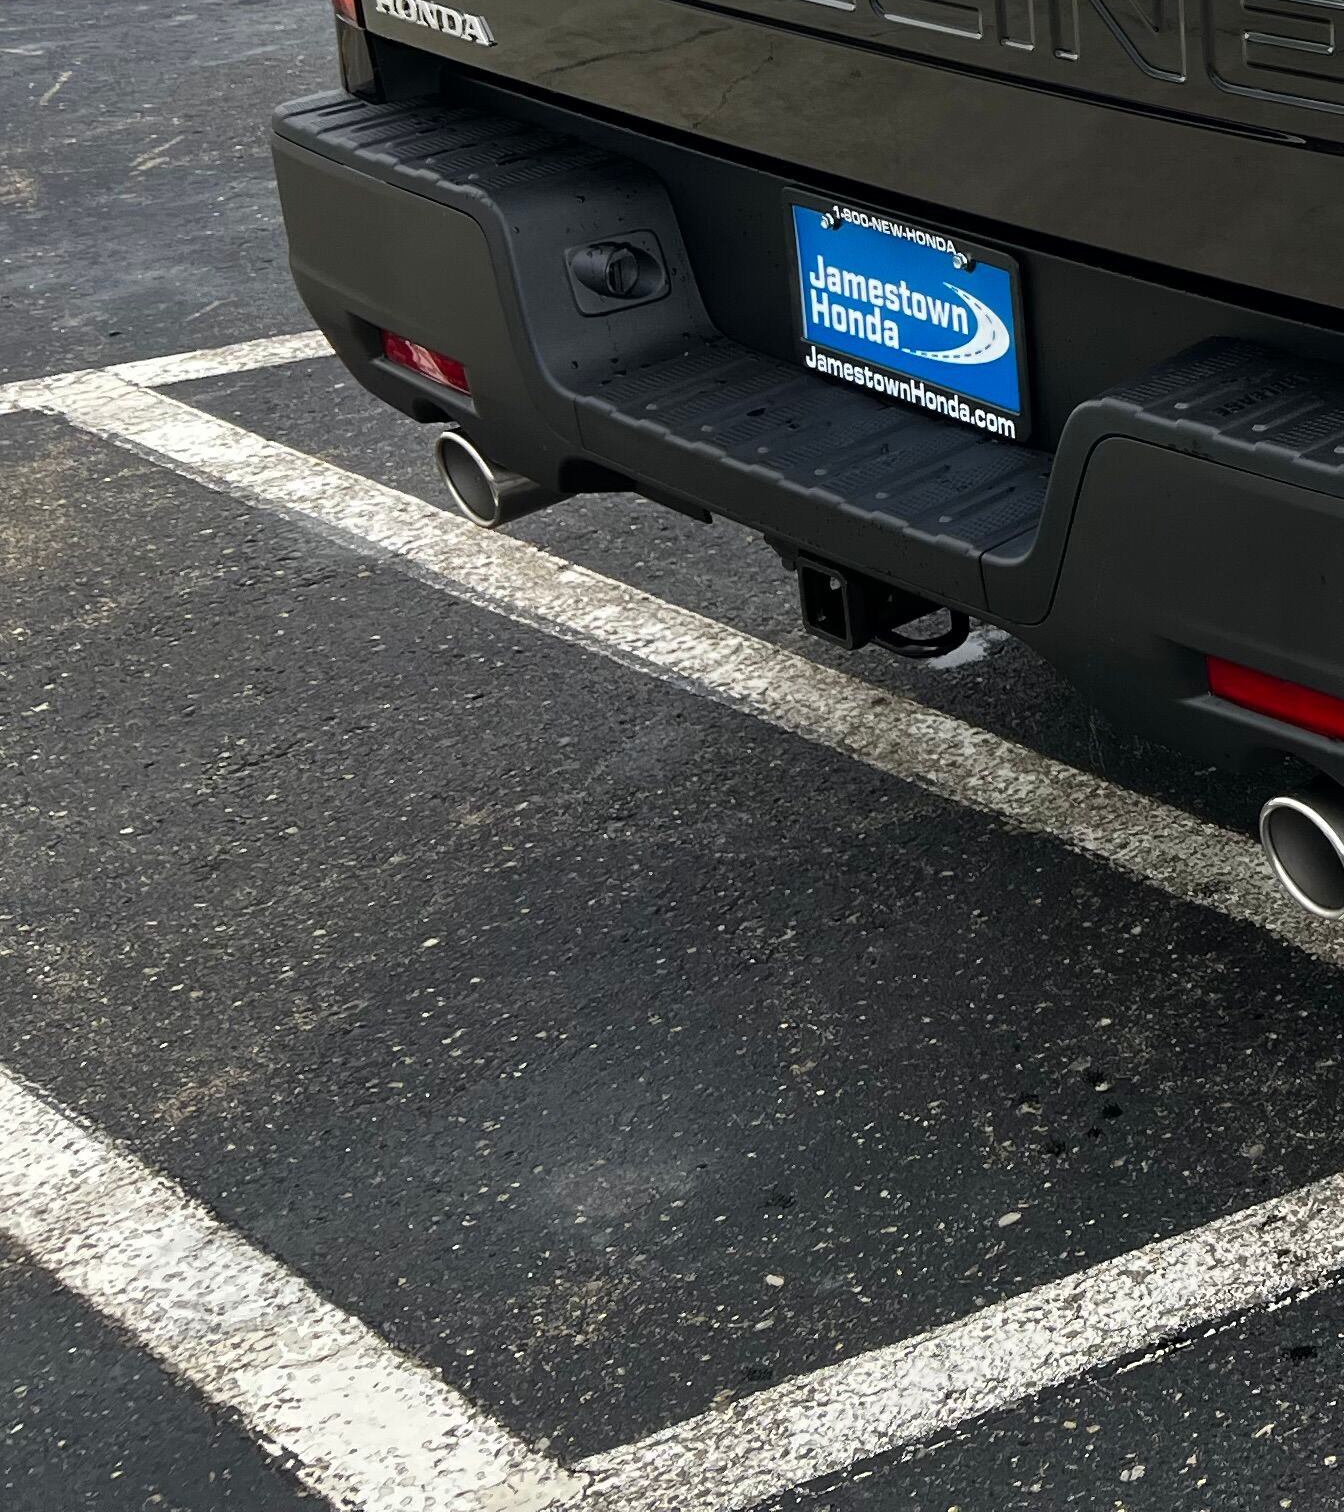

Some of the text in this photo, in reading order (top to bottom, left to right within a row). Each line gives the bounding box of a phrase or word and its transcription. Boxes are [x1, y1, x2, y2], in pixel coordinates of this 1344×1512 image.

[832, 205, 957, 255] 1-800-NEW-HONDA
[809, 254, 969, 336] Jamestown
[810, 288, 900, 350] Honda
[805, 345, 1016, 439] JamestownHonda.com
